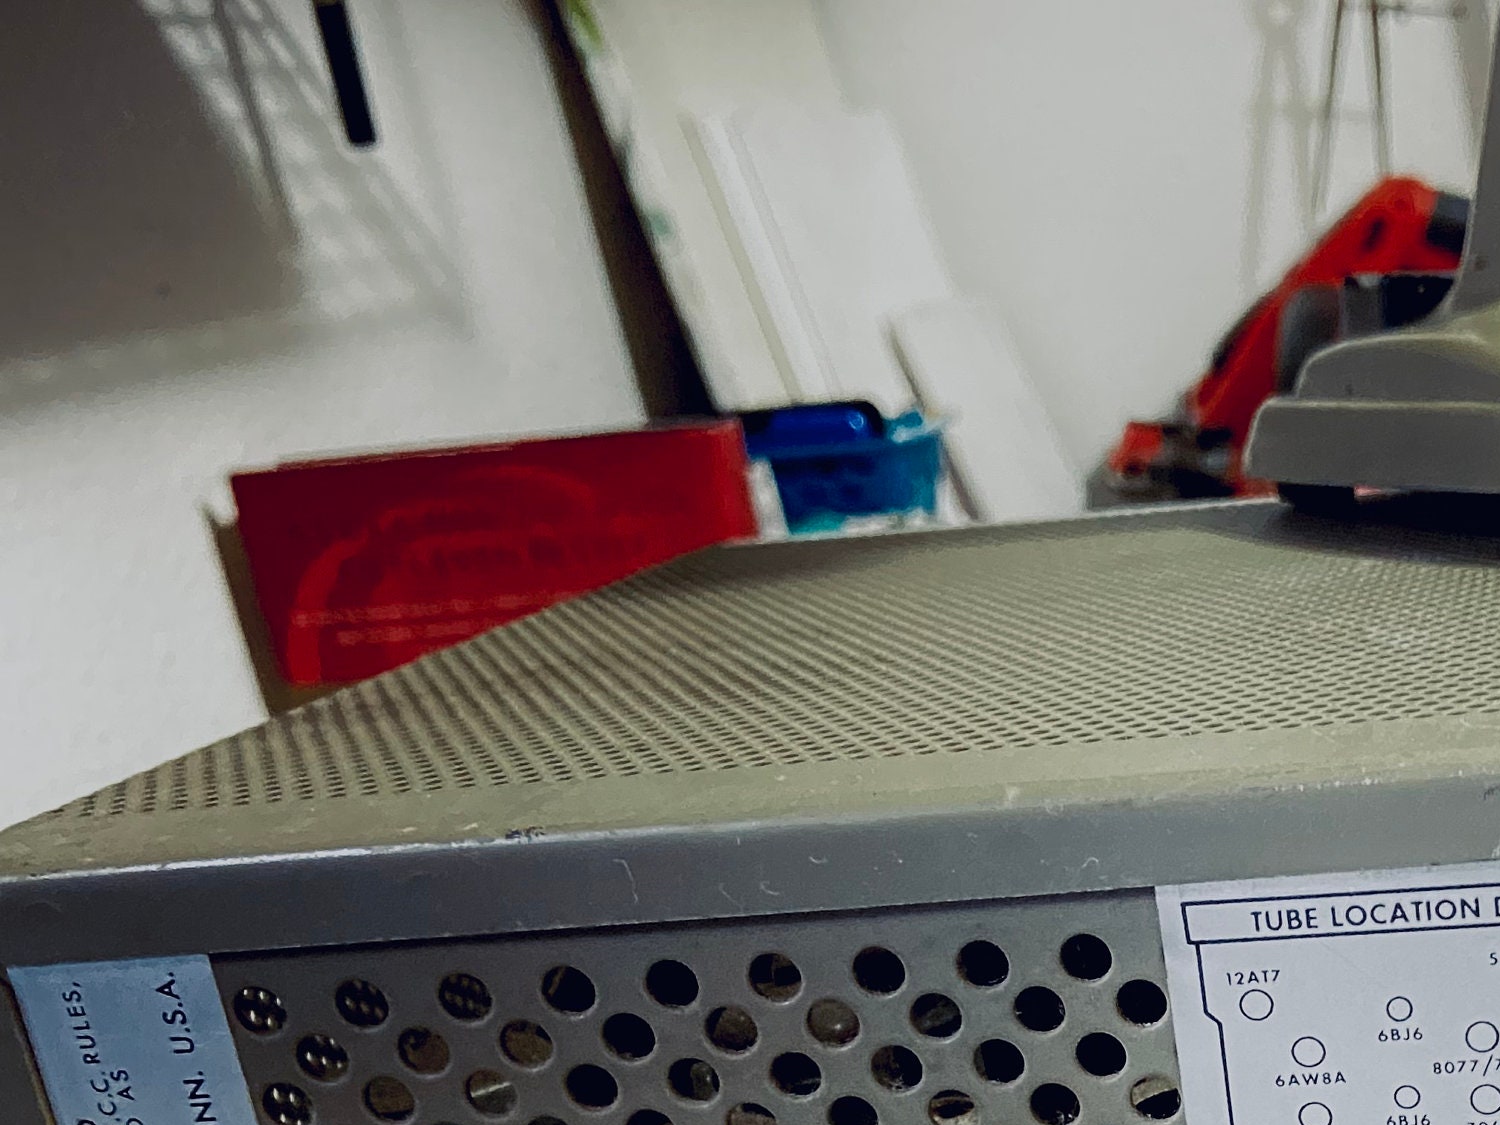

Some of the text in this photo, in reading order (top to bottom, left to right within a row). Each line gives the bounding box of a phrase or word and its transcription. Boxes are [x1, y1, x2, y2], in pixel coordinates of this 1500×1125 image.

[1251, 908, 1319, 932] TUBE
[1331, 897, 1481, 928] LOCATION
[1226, 969, 1280, 985] 12AT7
[62, 982, 101, 1064] RULES,
[155, 972, 194, 1054] U.S.A.
[1378, 1028, 1423, 1042] 6BJ6
[110, 1070, 136, 1100] AS
[1275, 1071, 1347, 1088] 6AW8A
